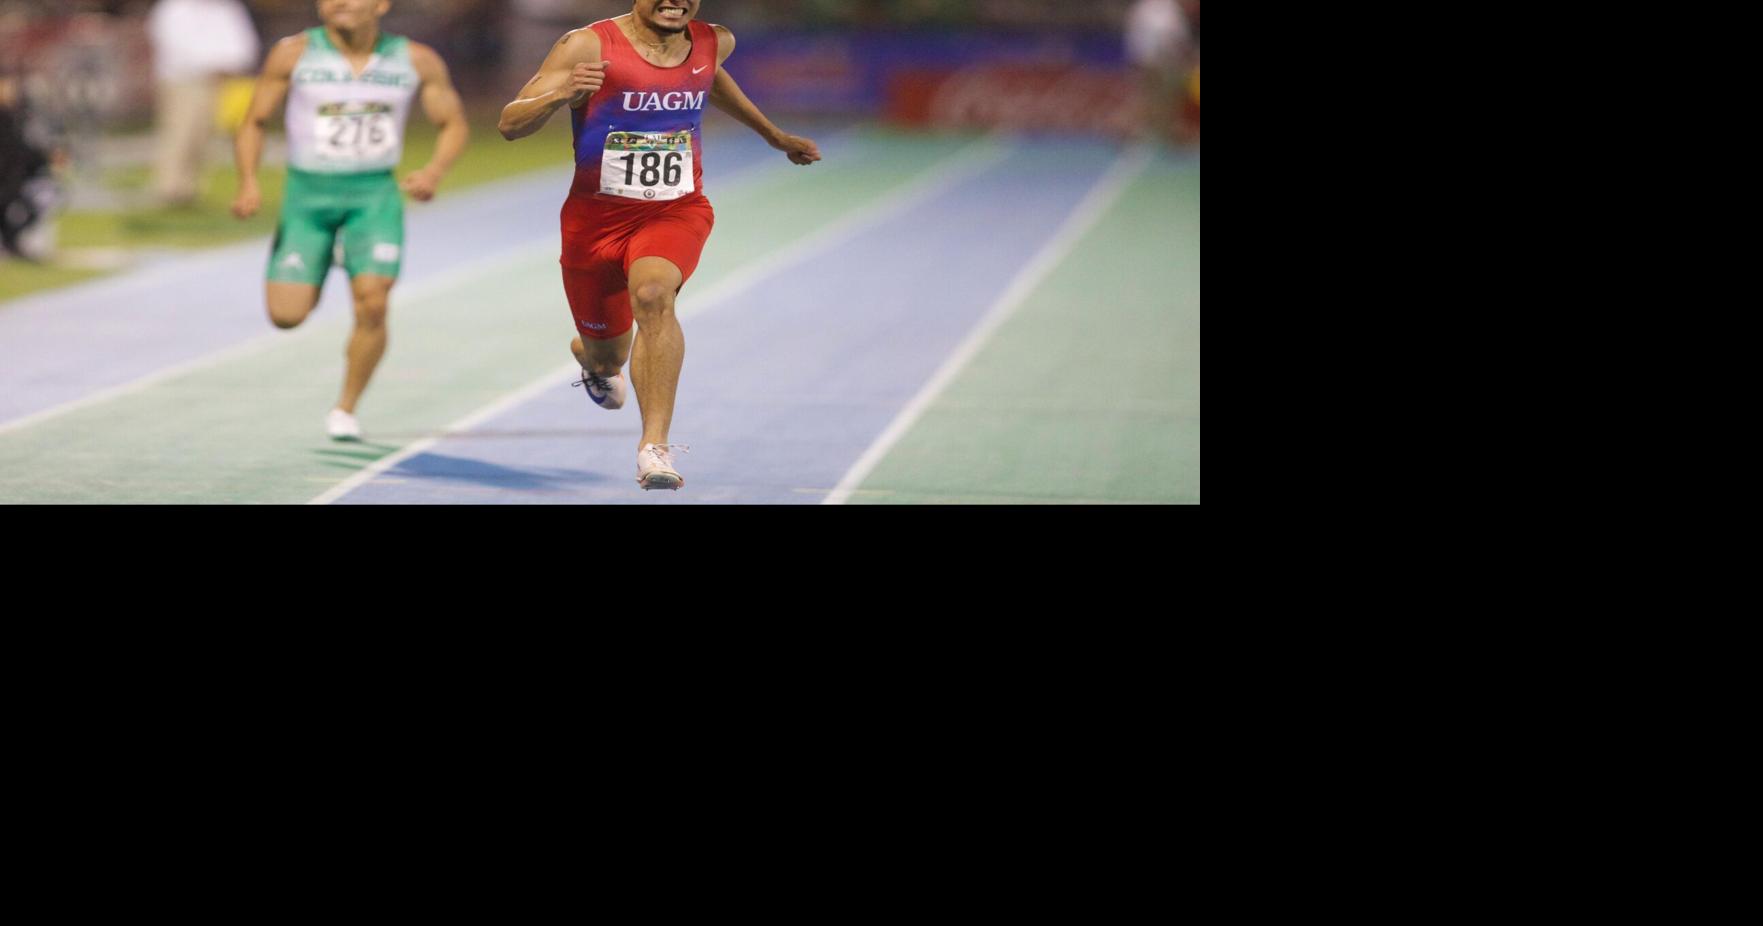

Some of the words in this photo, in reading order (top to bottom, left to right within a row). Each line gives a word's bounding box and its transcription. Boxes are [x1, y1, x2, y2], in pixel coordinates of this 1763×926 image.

[622, 91, 705, 111] UAGM
[328, 115, 387, 147] 276
[620, 152, 683, 187] 186
